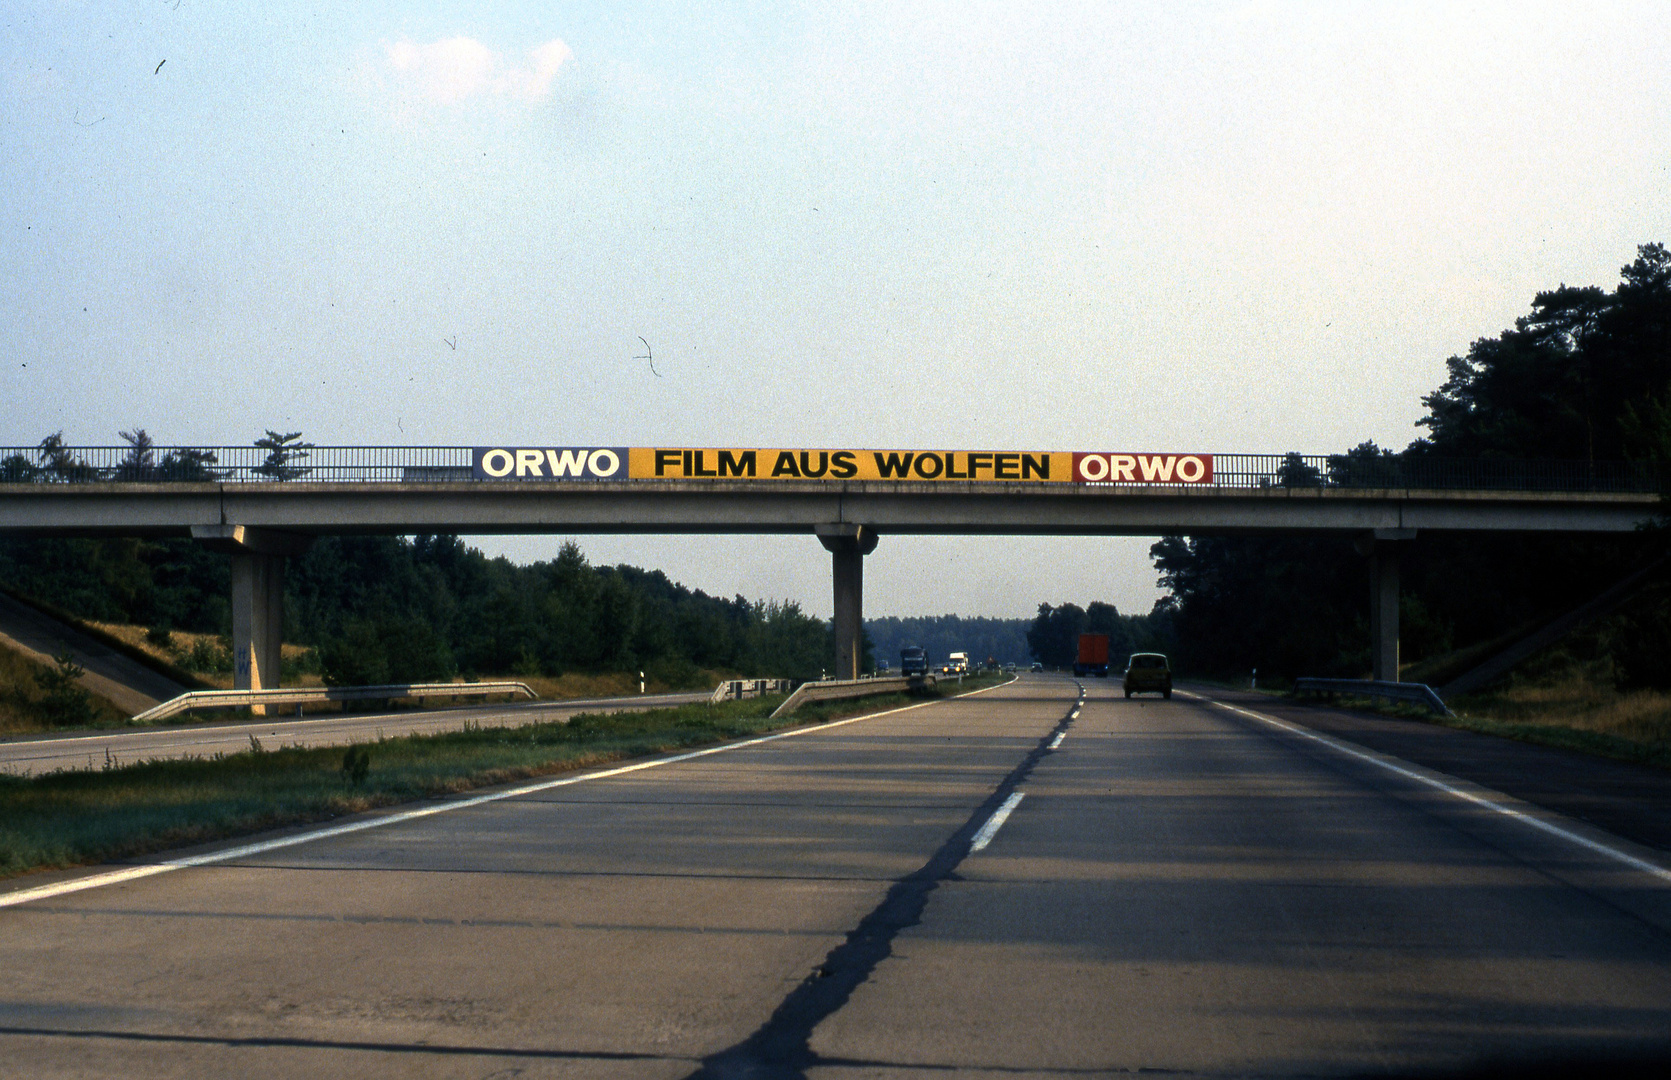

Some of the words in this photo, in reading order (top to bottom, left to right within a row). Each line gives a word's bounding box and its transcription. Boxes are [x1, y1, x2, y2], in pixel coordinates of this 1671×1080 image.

[482, 449, 620, 477] ORWO
[655, 450, 756, 477] FILM
[771, 451, 858, 478] AUS
[873, 452, 1050, 479] WOLFEN
[1079, 454, 1205, 482] ORWO
